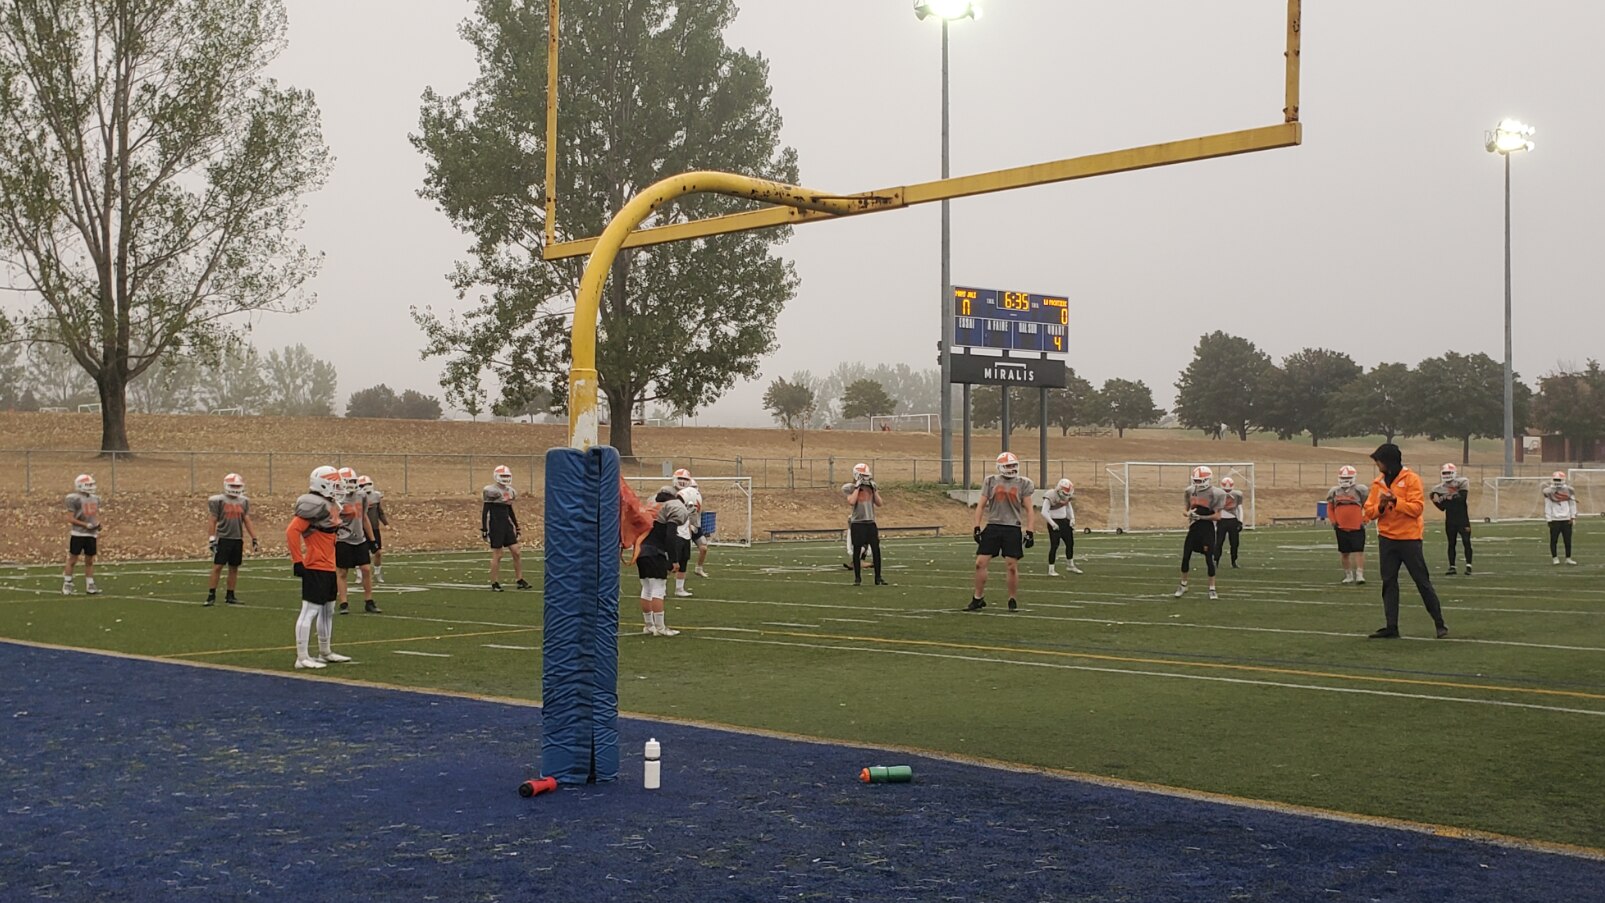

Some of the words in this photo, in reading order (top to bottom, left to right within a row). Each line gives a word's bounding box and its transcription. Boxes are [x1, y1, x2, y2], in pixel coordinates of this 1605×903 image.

[1005, 291, 1029, 310] 6:35
[1054, 336, 1062, 351] 4
[984, 367, 1034, 381] MIRALIS
